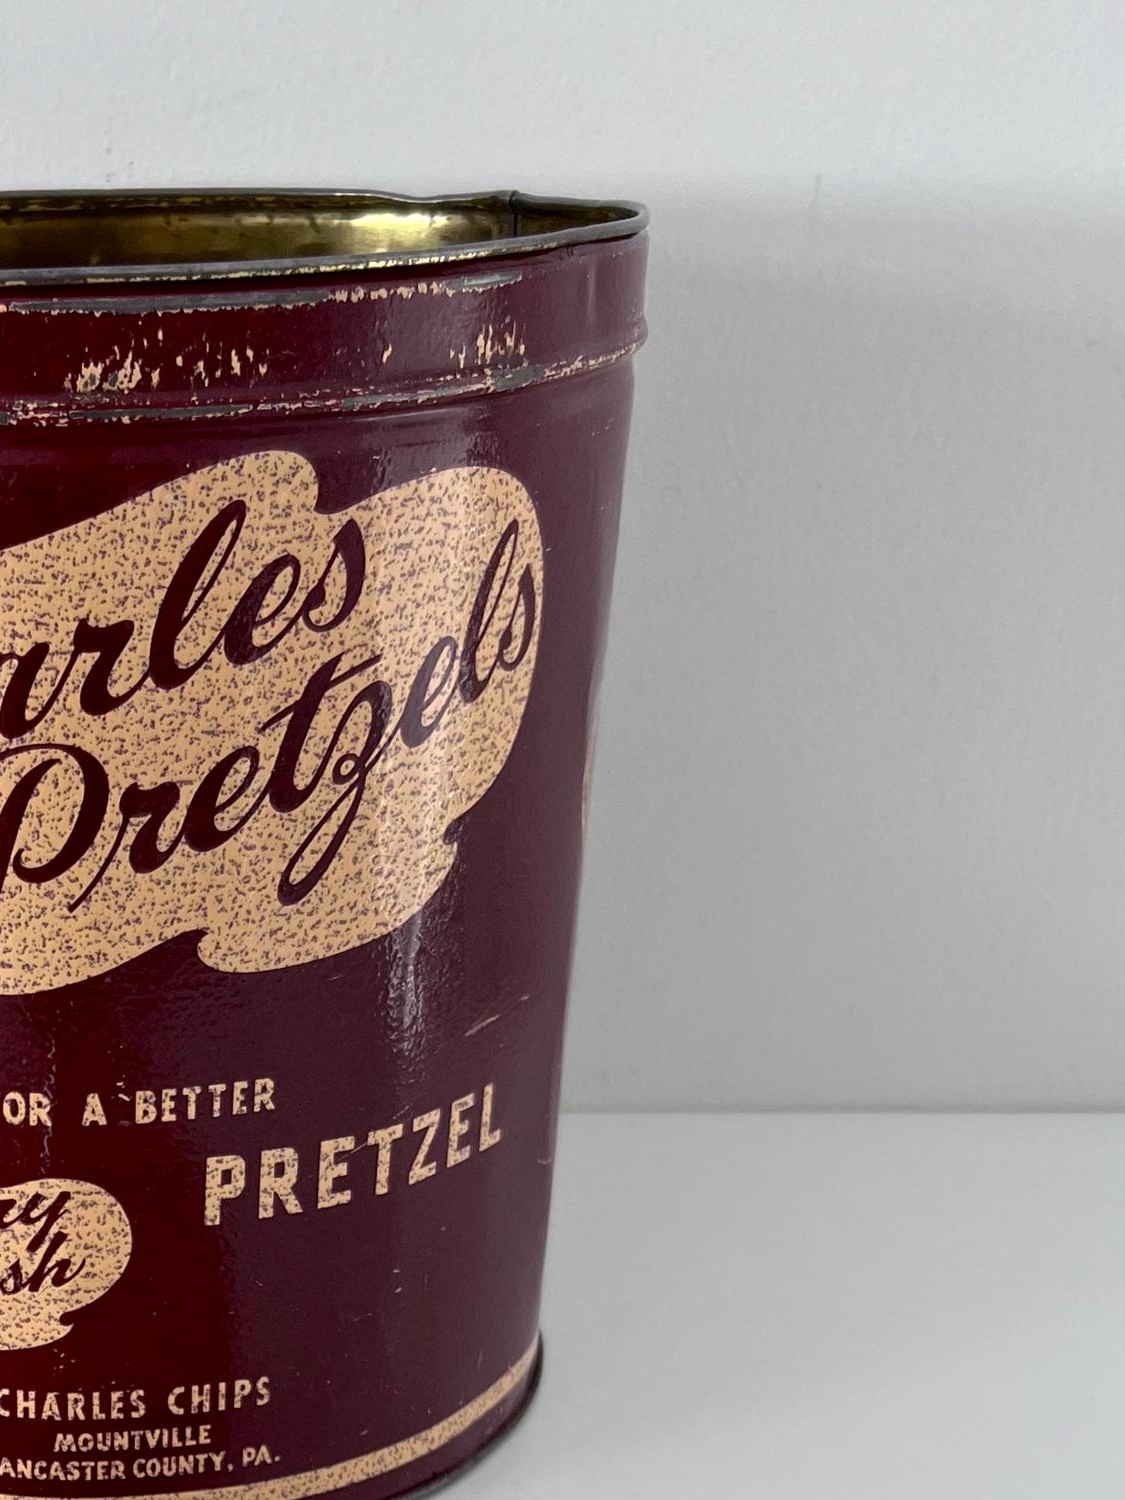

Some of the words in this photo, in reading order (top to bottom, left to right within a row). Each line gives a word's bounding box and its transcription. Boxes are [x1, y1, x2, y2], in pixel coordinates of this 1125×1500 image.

[81, 1093, 107, 1127] A
[134, 1077, 277, 1125] BETTER
[203, 1081, 502, 1226] PRETZEL
[167, 1376, 270, 1416] CHIPS
[53, 1424, 212, 1453] MOUNTVILLE
[132, 1450, 234, 1479] COUNTY,
[241, 1445, 281, 1468] PA.
